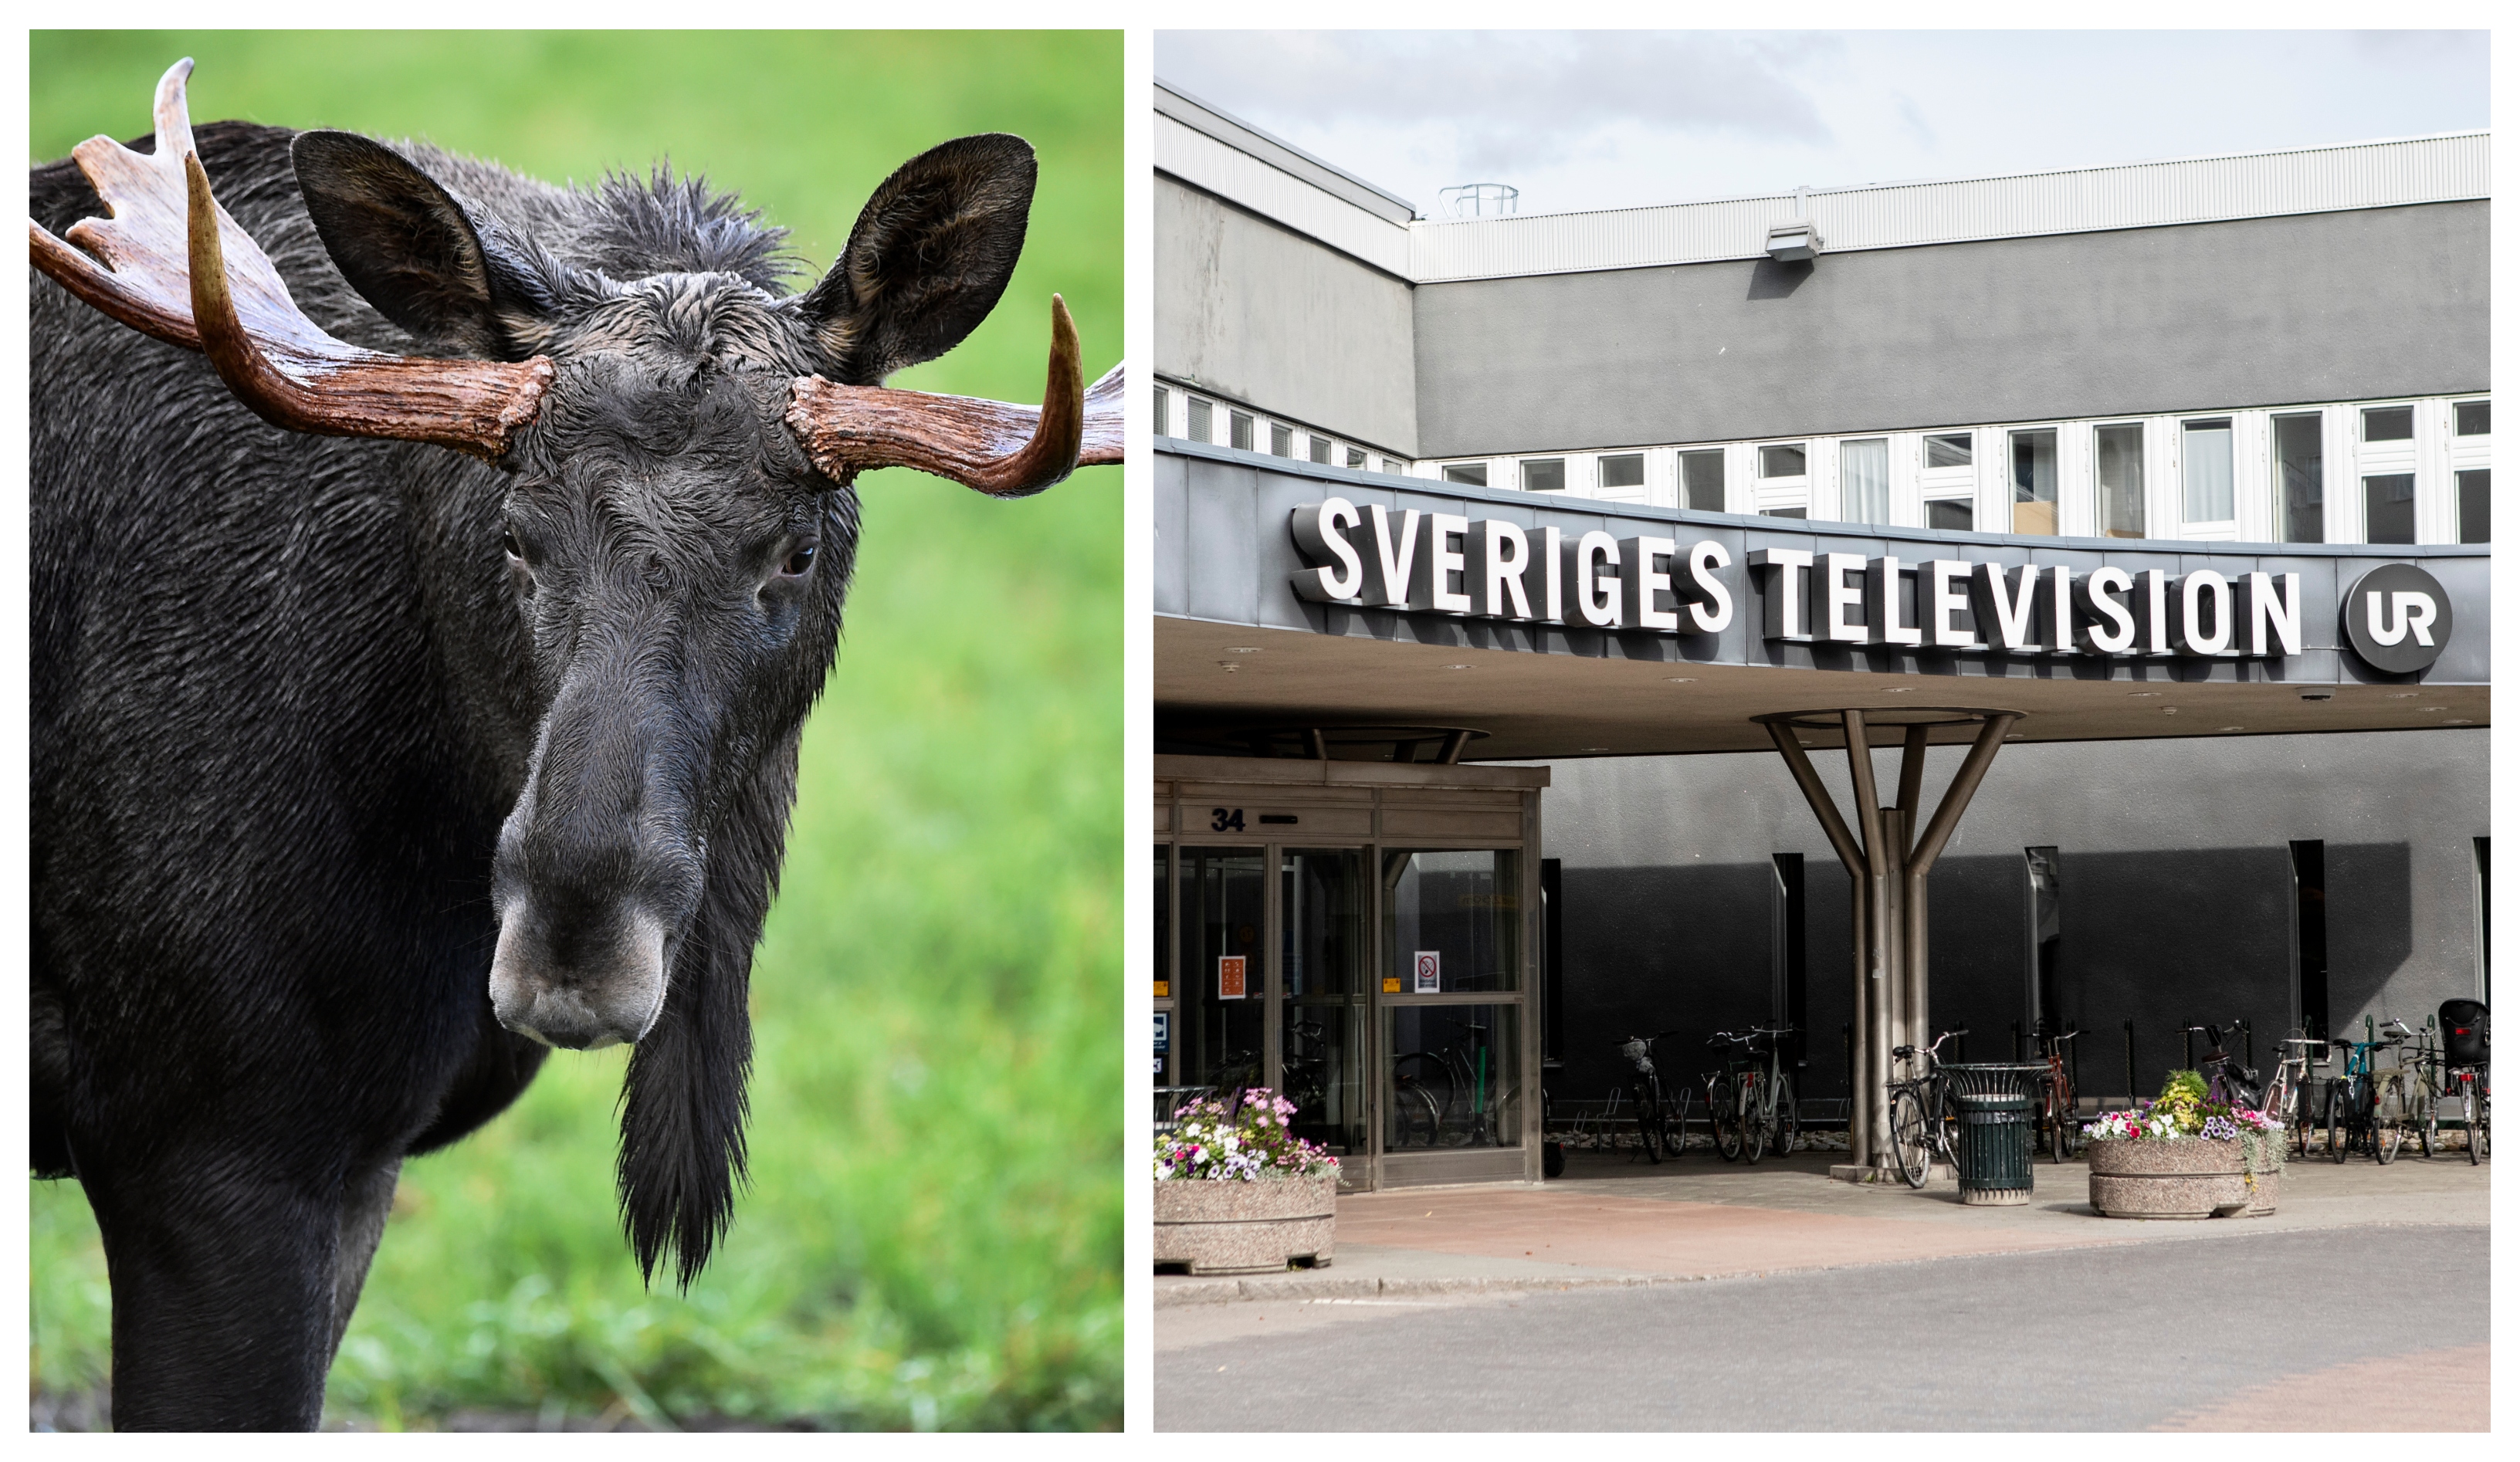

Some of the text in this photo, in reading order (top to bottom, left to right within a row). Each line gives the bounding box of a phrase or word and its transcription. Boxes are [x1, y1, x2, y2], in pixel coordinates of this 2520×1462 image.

[1317, 496, 2302, 656] SVERIGES TELEVISION
[2366, 591, 2437, 647] UR
[1211, 807, 1246, 832] 34
